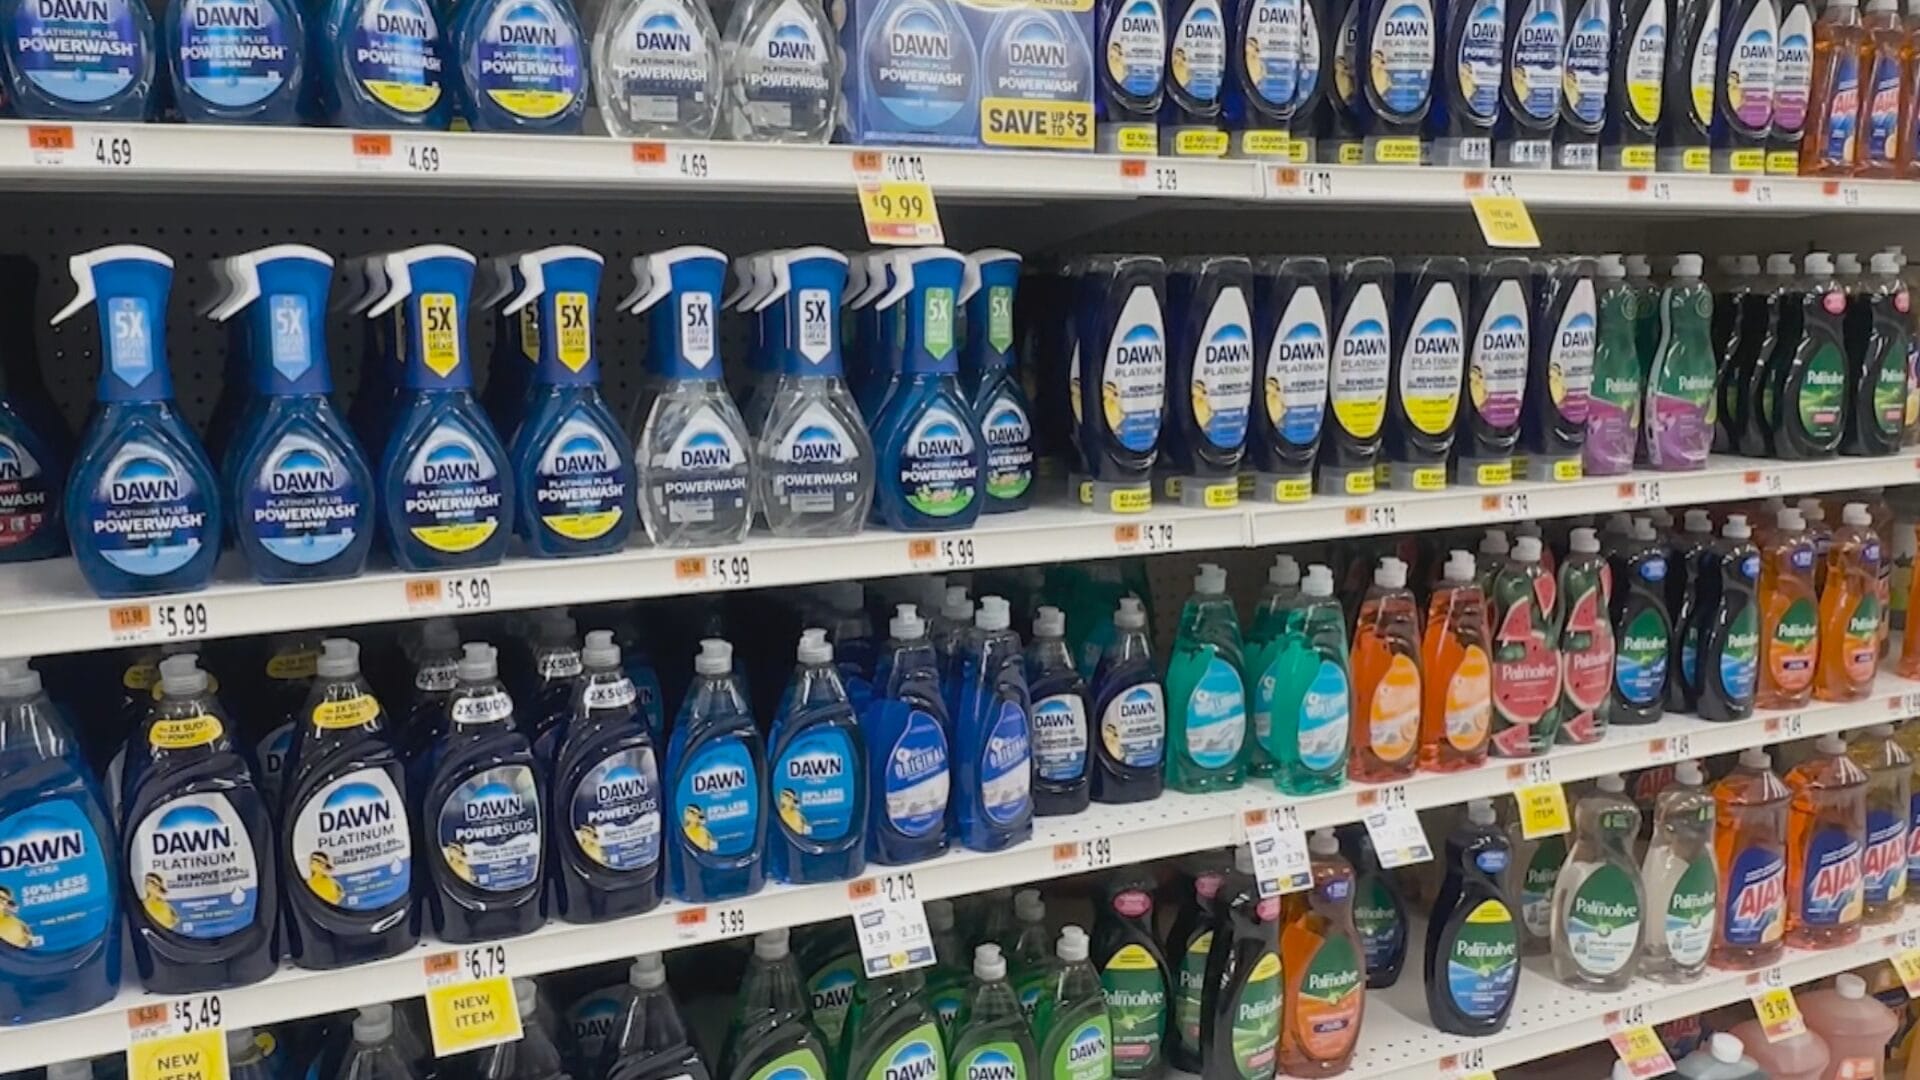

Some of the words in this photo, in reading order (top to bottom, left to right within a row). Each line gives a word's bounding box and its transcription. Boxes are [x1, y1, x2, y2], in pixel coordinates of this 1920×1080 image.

[39, 0, 109, 21] DAWN
[196, 6, 260, 27] DAWN
[1259, 7, 1298, 24] DAWN
[31, 27, 87, 38] PLATINUM
[90, 29, 119, 40] PLUS
[377, 13, 428, 38] DAWN
[500, 24, 557, 46] DAWN
[1122, 17, 1160, 34] DAWN
[1185, 24, 1221, 39] DAWN
[1384, 21, 1429, 38] DAWN
[19, 37, 135, 57] POWERWASH
[636, 32, 691, 52] DAWN
[768, 41, 816, 61] DAWN
[892, 33, 948, 58] DAWN
[181, 46, 284, 60] POWERWASH
[357, 49, 442, 72] POWERWASH
[1010, 43, 1065, 67] DAWN
[1777, 48, 1810, 63] DAWN
[482, 59, 575, 76] POWERWASH
[618, 65, 707, 83] POWERWASH
[880, 67, 962, 86] POWERWASH
[751, 72, 829, 90] POWERWASH
[999, 77, 1077, 93] POWERWASH
[989, 108, 1047, 135] SAVE
[1051, 111, 1066, 123] UP
[1052, 123, 1065, 136] TO
[276, 307, 302, 334] 5X
[427, 307, 452, 331] 5X
[562, 304, 584, 329] 5X
[687, 303, 708, 326] 5X
[804, 301, 826, 323] 5X
[115, 311, 144, 339] 5X
[1343, 338, 1387, 356] DAWN
[1415, 337, 1460, 355] DAWN
[1483, 332, 1526, 350] DAWN
[1117, 345, 1163, 364] DAWN
[1206, 344, 1250, 363] DAWN
[1280, 343, 1325, 361] DAWN
[1807, 369, 1844, 384] Palmolive
[988, 427, 1025, 443] DAWN
[682, 448, 731, 467] DAWN
[792, 442, 841, 460] DAWN
[918, 440, 963, 456] DAWN
[423, 462, 480, 483] DAWN
[555, 454, 607, 473] DAWN
[273, 472, 334, 492] DAWN
[549, 479, 592, 488] PLATINUM
[594, 477, 614, 486] PLUS
[776, 471, 858, 486] POWERWASH
[901, 467, 977, 482] POWERWASH
[112, 480, 178, 502] DAWN
[417, 488, 464, 498] PLATINUM
[466, 486, 488, 495] PLUS
[537, 485, 623, 502] POWERWASH
[665, 478, 746, 495] POWERWASH
[266, 498, 316, 508] PLATINUM
[318, 496, 342, 505] PLUS
[406, 493, 500, 513] POWERWASH
[106, 507, 160, 519] PLATINUM
[162, 505, 189, 515] PLUS
[255, 504, 356, 522] POWERWASH
[94, 514, 203, 533] POWERWASH
[712, 557, 750, 584] $5.99
[448, 578, 491, 609] $5.99
[159, 603, 207, 637] $5.99
[1624, 636, 1667, 650] Palmolive
[1502, 664, 1557, 681] Palmolive
[590, 688, 605, 701] 2X
[456, 702, 473, 715] 2X
[474, 696, 508, 714] SUDS
[1121, 702, 1156, 717] DAWN
[1035, 713, 1075, 728] DAWN
[790, 758, 841, 777] DAWN
[599, 777, 647, 800] DAWN
[695, 770, 746, 793] DAWN
[467, 796, 521, 819] DAWN
[588, 798, 657, 822] POWERSUDS
[1532, 796, 1552, 806] NEW
[320, 800, 390, 833] DAWN
[1534, 807, 1555, 819] ITEM
[318, 824, 394, 848] PLATINUM
[456, 819, 534, 841] POWERSUDS
[0, 831, 82, 869] DAWN
[152, 826, 231, 855] DAWN
[152, 851, 236, 870] PLATINUM
[177, 870, 219, 882] REMOVE
[1814, 859, 1861, 898] AJAX
[881, 873, 916, 902] $2.79
[1738, 876, 1785, 917] AJAX
[1576, 897, 1637, 918] Palmolive
[1457, 940, 1516, 957] Palmolive
[465, 945, 505, 979] $6.79
[1309, 970, 1359, 990] Palmolive
[453, 994, 491, 1010] NEW
[812, 986, 852, 1010] DAW
[1101, 988, 1164, 1007] Palmolive
[175, 995, 221, 1033] $5.49
[456, 1010, 495, 1028] ITEM
[1070, 1037, 1106, 1062] DAWN
[157, 1053, 200, 1071] NEW
[886, 1056, 937, 1080] DAWN
[969, 1065, 1016, 1080] DAWN
